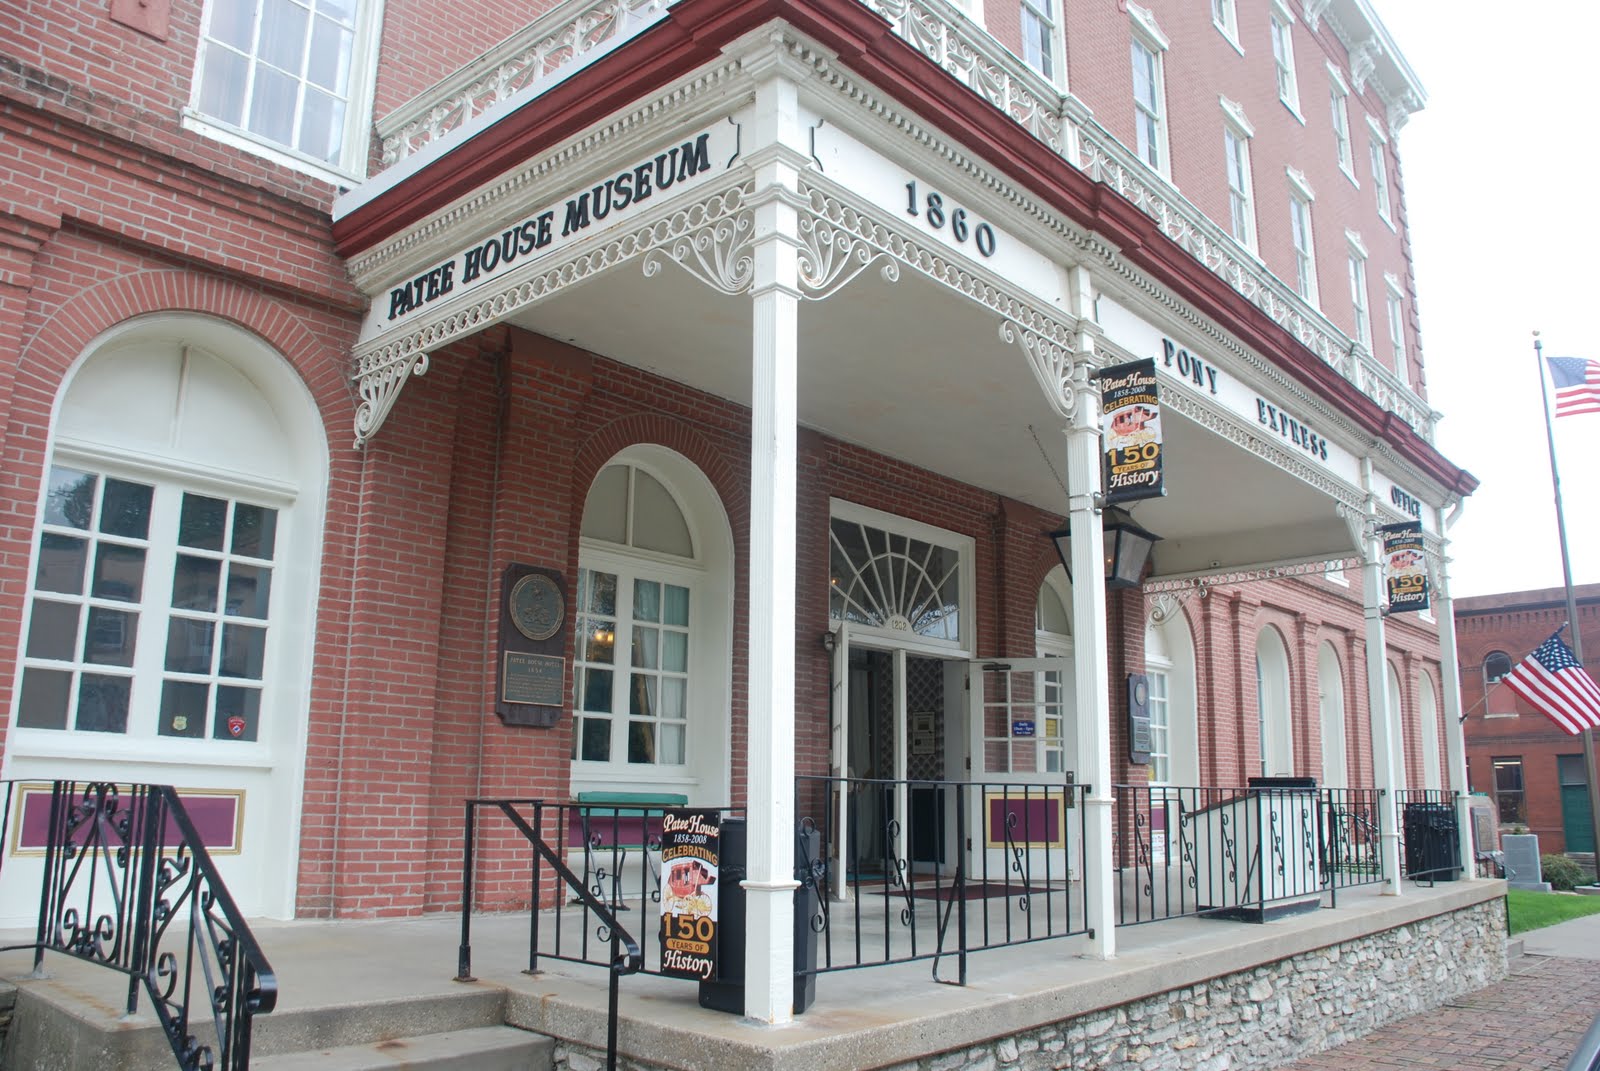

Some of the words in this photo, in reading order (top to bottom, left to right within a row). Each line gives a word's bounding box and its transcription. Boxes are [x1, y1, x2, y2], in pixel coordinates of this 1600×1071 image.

[388, 260, 455, 320] PATEE
[462, 210, 554, 285] HOUSE
[561, 133, 711, 237] MUSEUM
[905, 180, 996, 258] 1860
[1162, 337, 1217, 394] PONY
[1102, 377, 1127, 393] Patee
[1125, 371, 1157, 388] House
[1113, 386, 1147, 399] 1858-2008
[1103, 394, 1158, 414] CELEBRATING
[1256, 398, 1328, 461] EXPRESS
[1108, 441, 1160, 466] 150
[1109, 470, 1159, 488] History
[1391, 485, 1421, 519] OFFICE
[1389, 574, 1425, 588] 150
[1391, 592, 1425, 603] History
[663, 813, 689, 833] Patee
[688, 814, 719, 838] House
[673, 833, 708, 844] 1858-2008
[662, 844, 718, 867] CELEBRATING
[663, 912, 714, 942] 150
[671, 940, 693, 952] YEARS
[694, 943, 705, 952] OF
[663, 950, 713, 980] History
